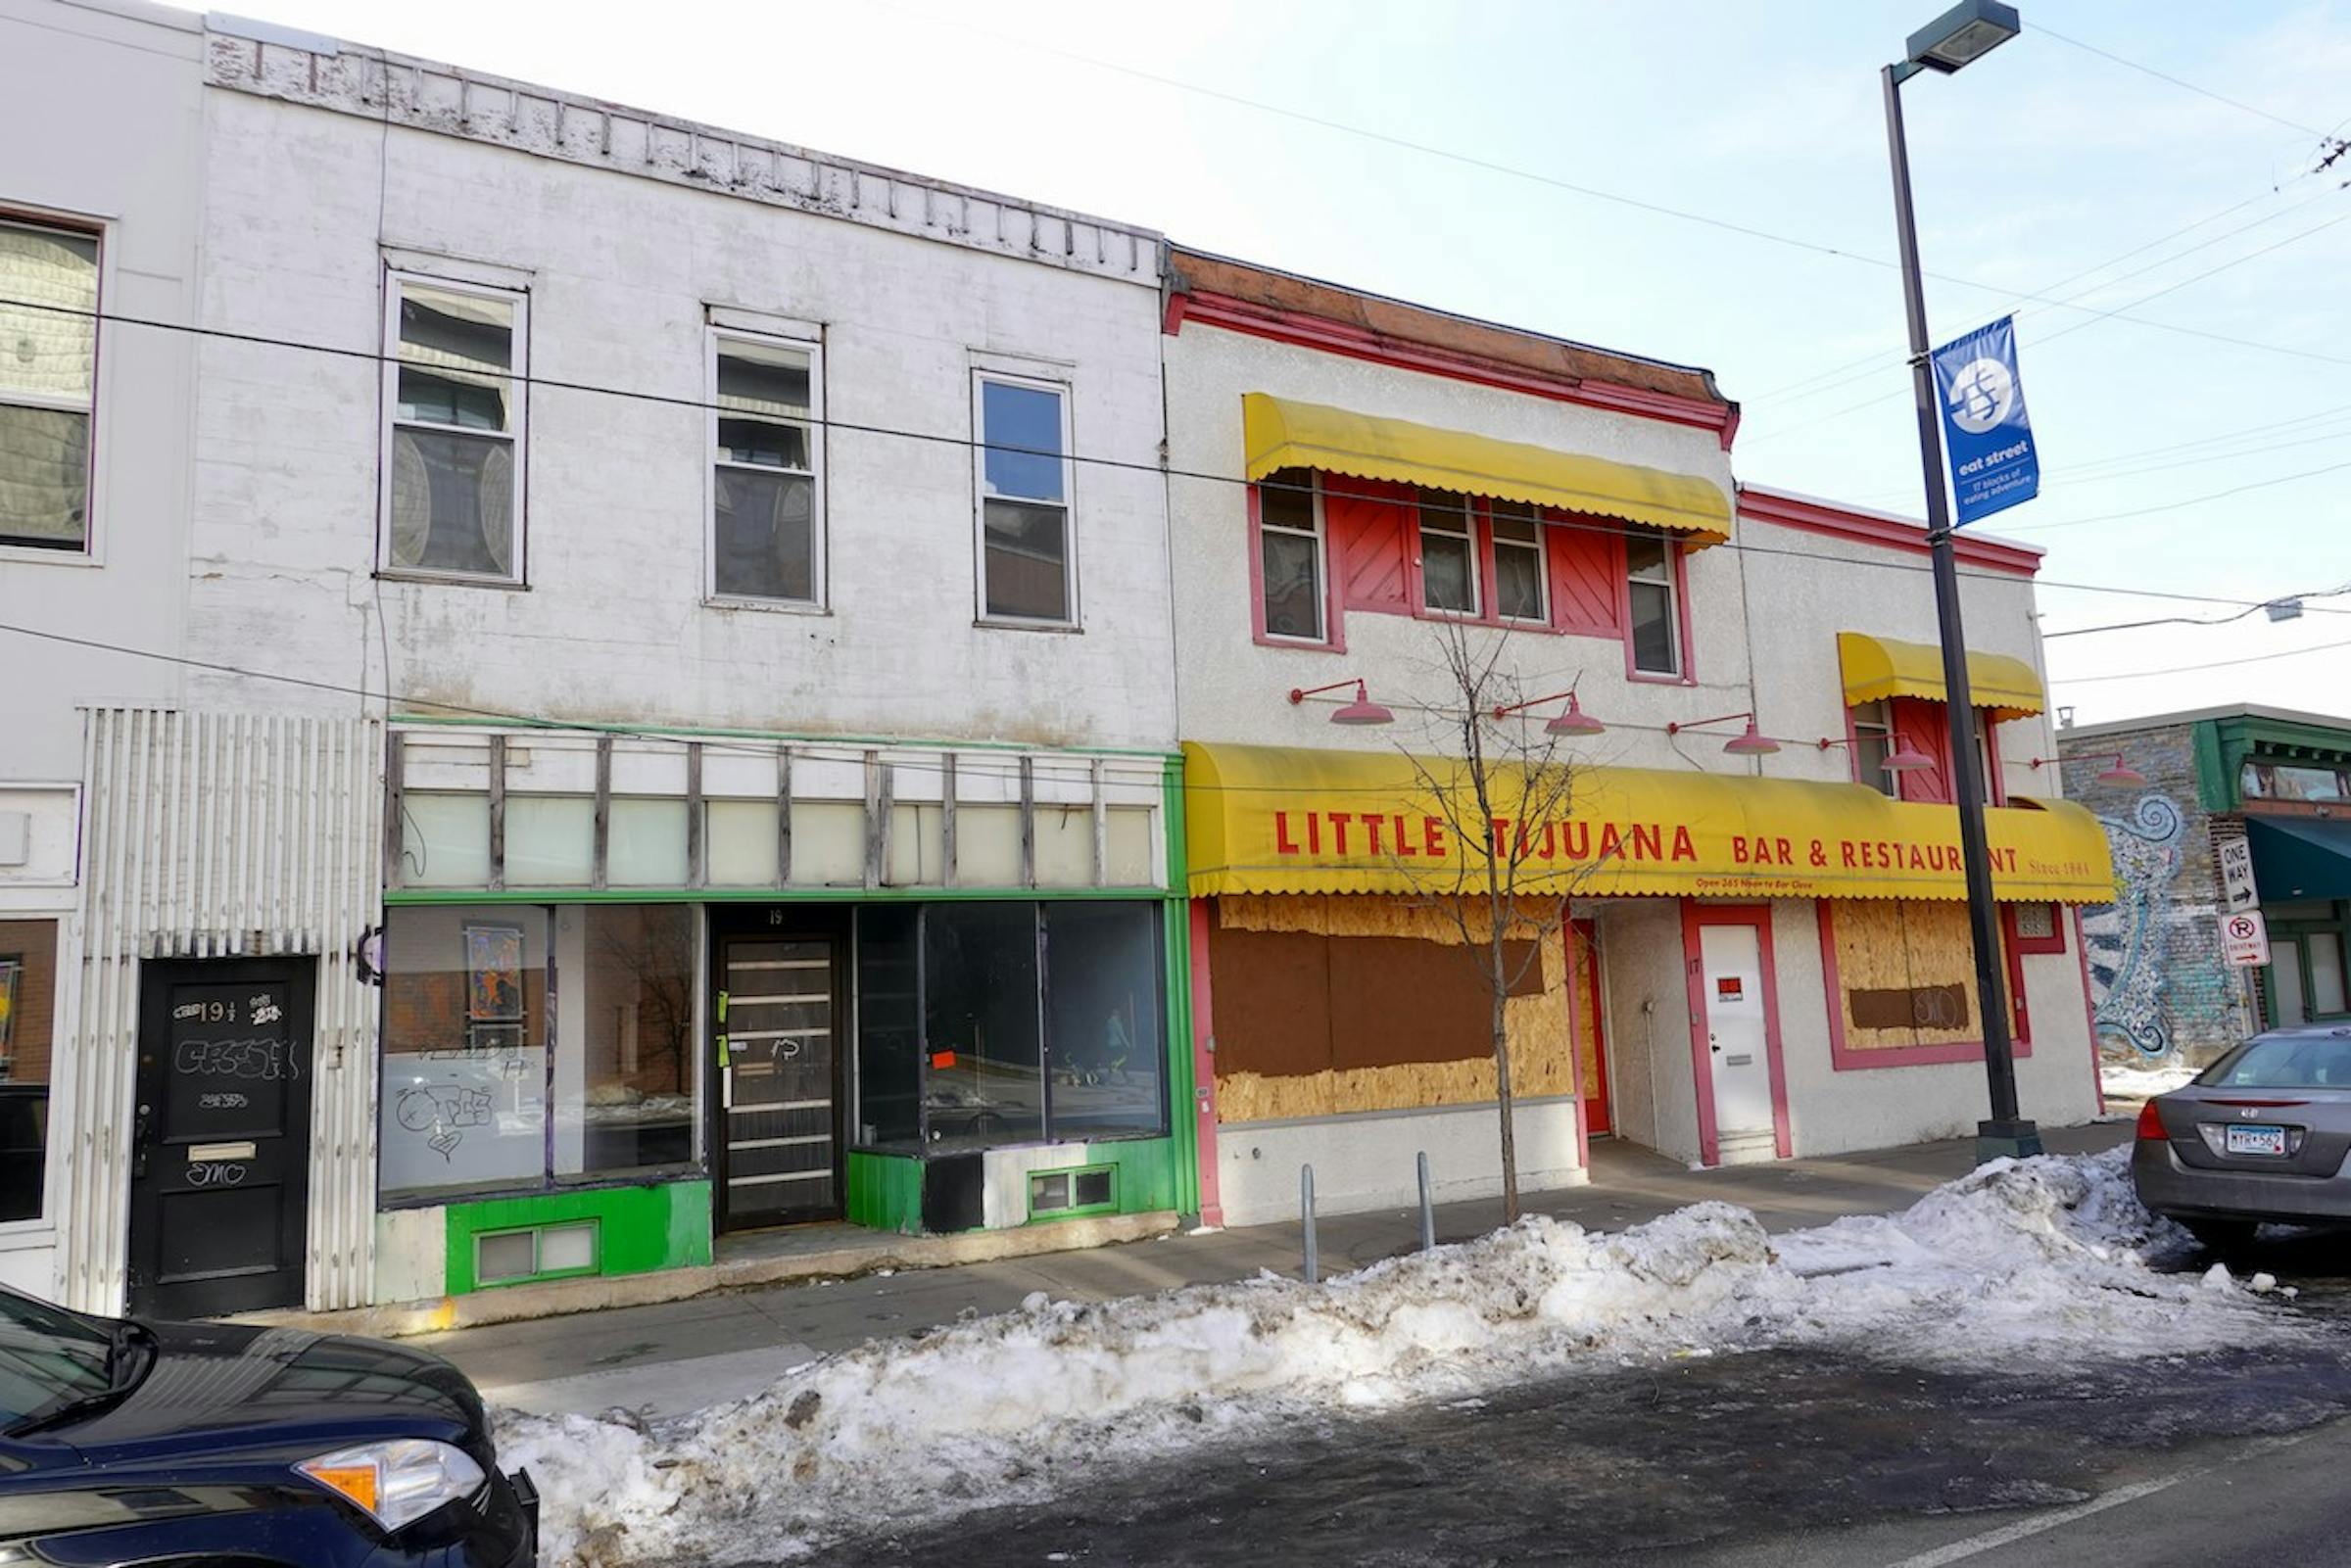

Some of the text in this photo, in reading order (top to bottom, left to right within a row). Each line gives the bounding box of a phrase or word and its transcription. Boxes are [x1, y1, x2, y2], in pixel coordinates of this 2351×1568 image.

[1959, 440, 2029, 476] eat street
[1963, 475, 2032, 505] eating adventure
[1982, 473, 2010, 489] blocks
[1275, 812, 1447, 858] LITTLE
[1489, 818, 1699, 863] TIJUANA
[1732, 835, 1795, 866] BAR
[1808, 839, 1827, 868] &
[1842, 841, 2017, 875] RESTAURNT
[2225, 844, 2246, 864] ONE
[2228, 864, 2249, 882] WAY
[1696, 878, 1719, 888] Open
[770, 909, 784, 926] 19
[1690, 959, 1699, 975] 17
